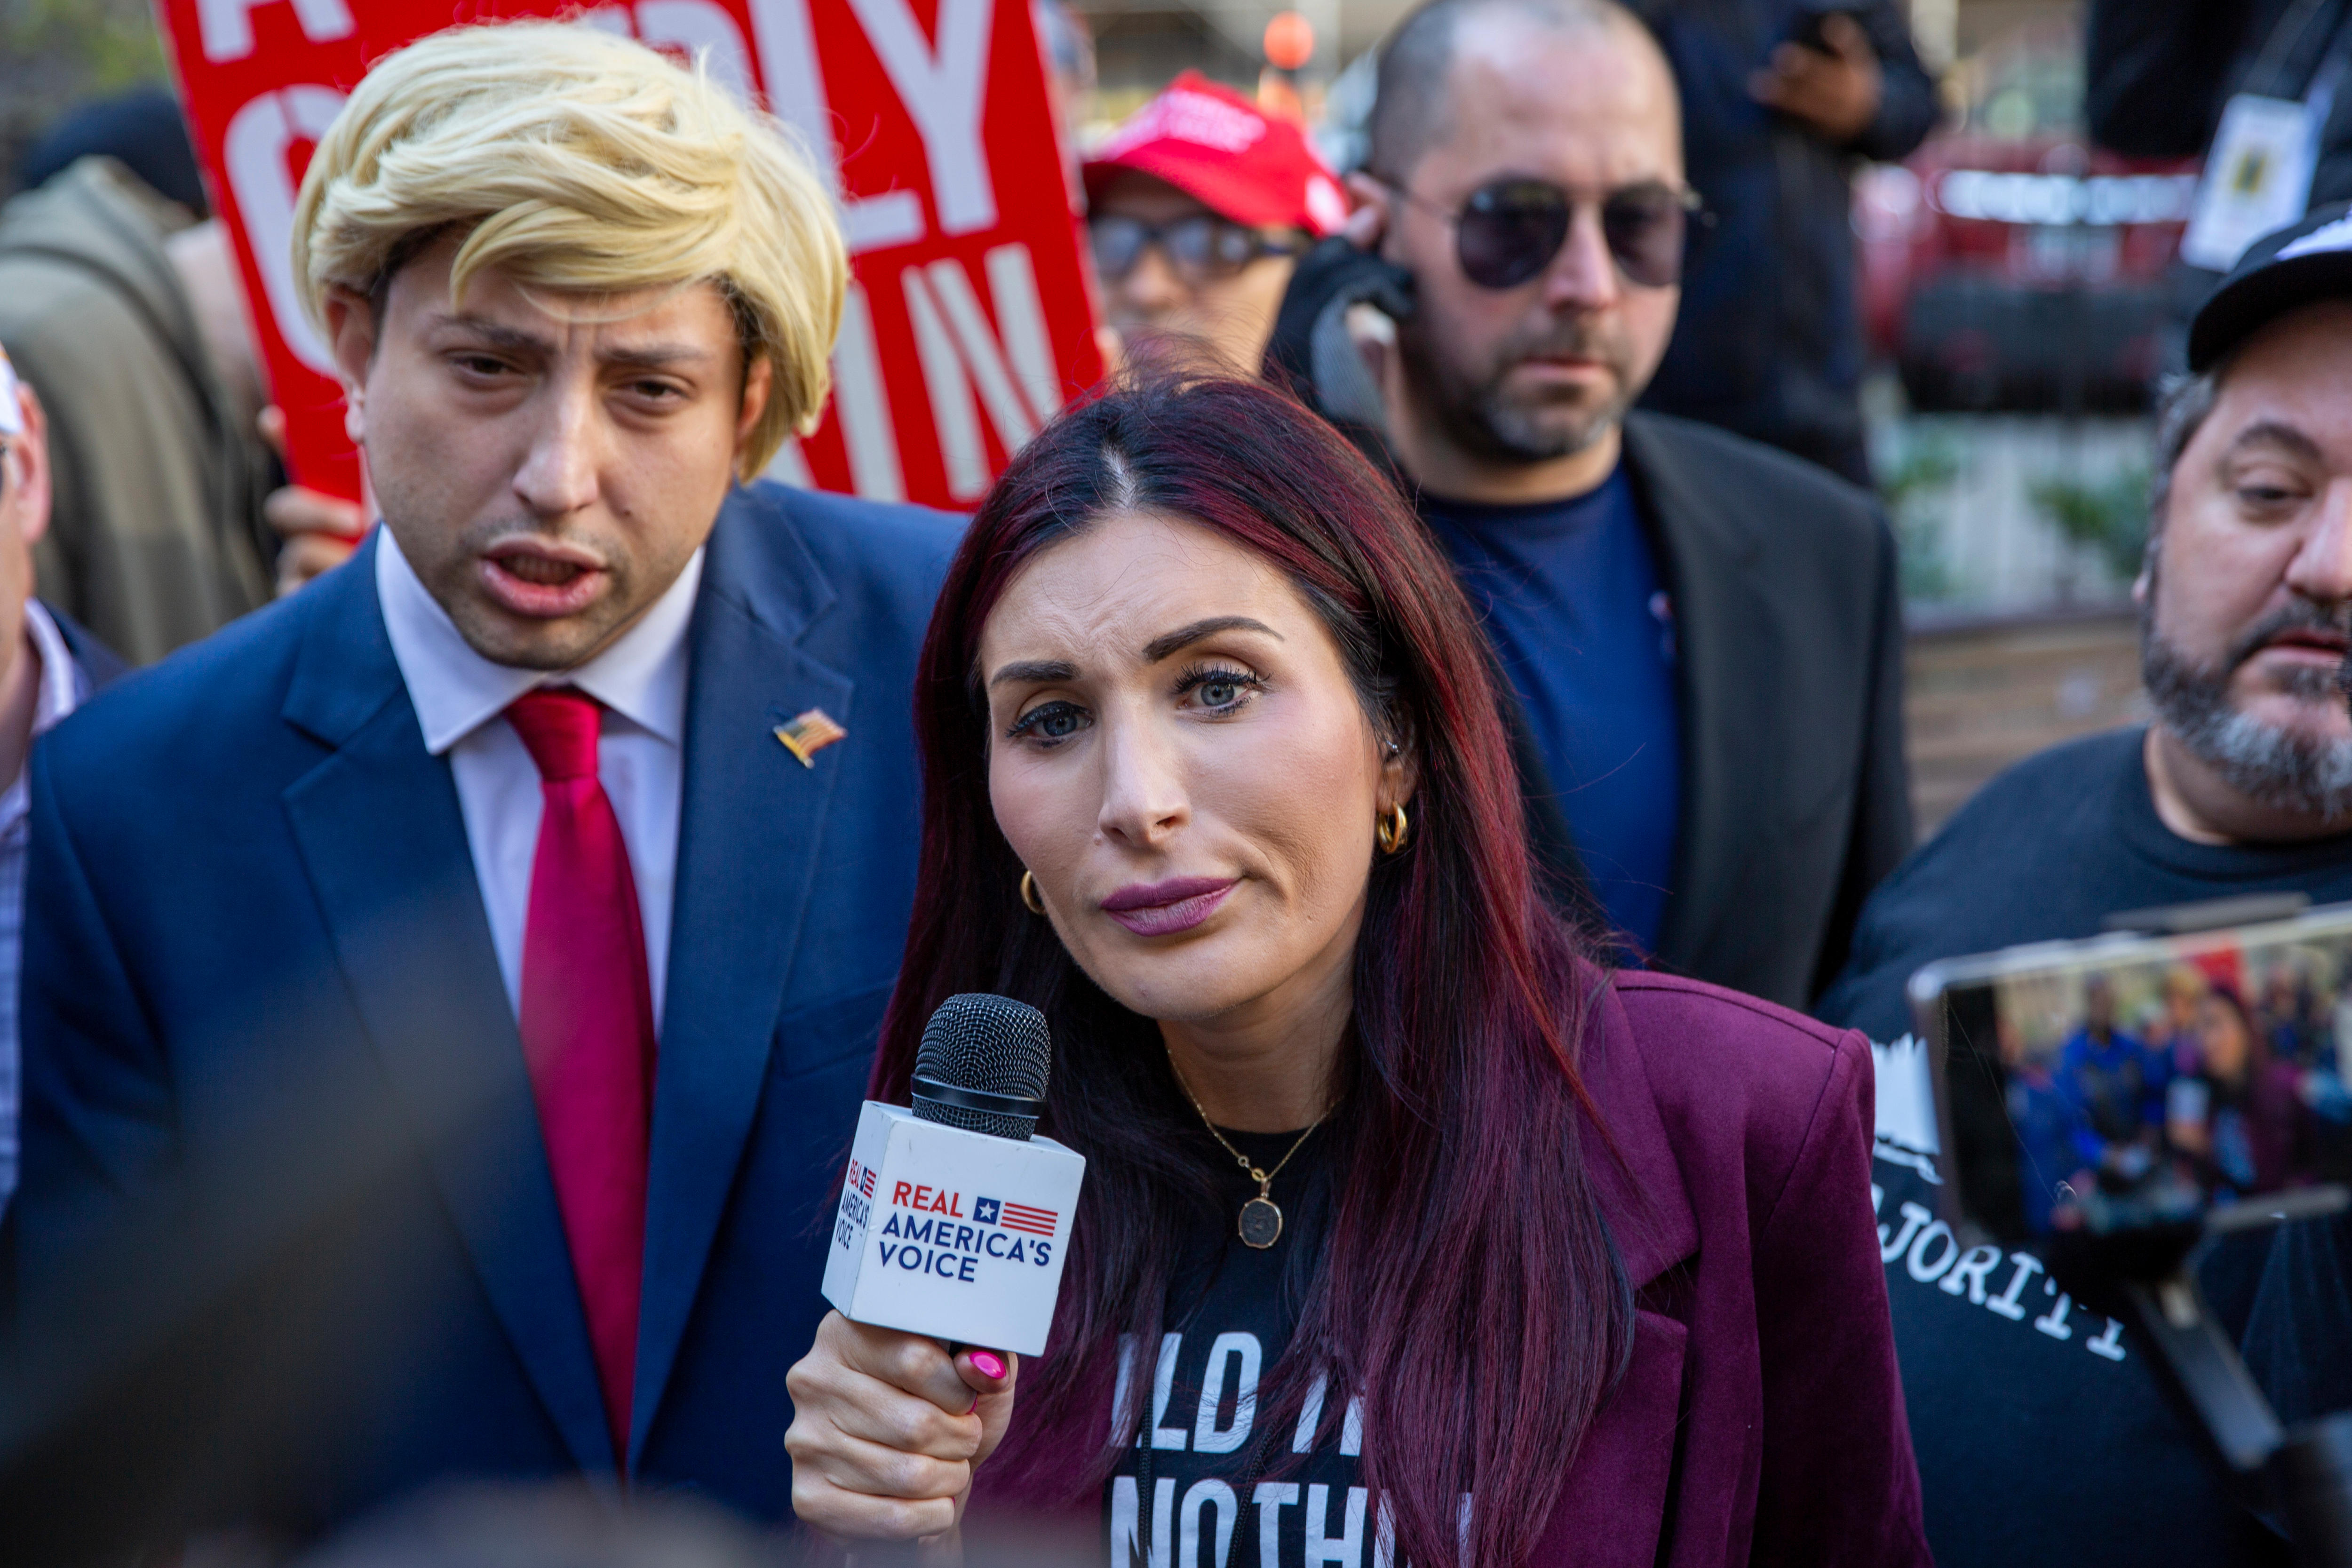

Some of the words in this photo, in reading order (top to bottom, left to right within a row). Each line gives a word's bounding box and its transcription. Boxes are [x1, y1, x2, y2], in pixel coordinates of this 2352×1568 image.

[848, 1158, 862, 1189] REAL
[841, 1189, 869, 1230] AMERICA'S
[892, 1180, 963, 1218] REAL
[835, 1217, 853, 1251] VOICE
[882, 1212, 1051, 1267] AMERICA'S
[879, 1241, 978, 1283] VOICE
